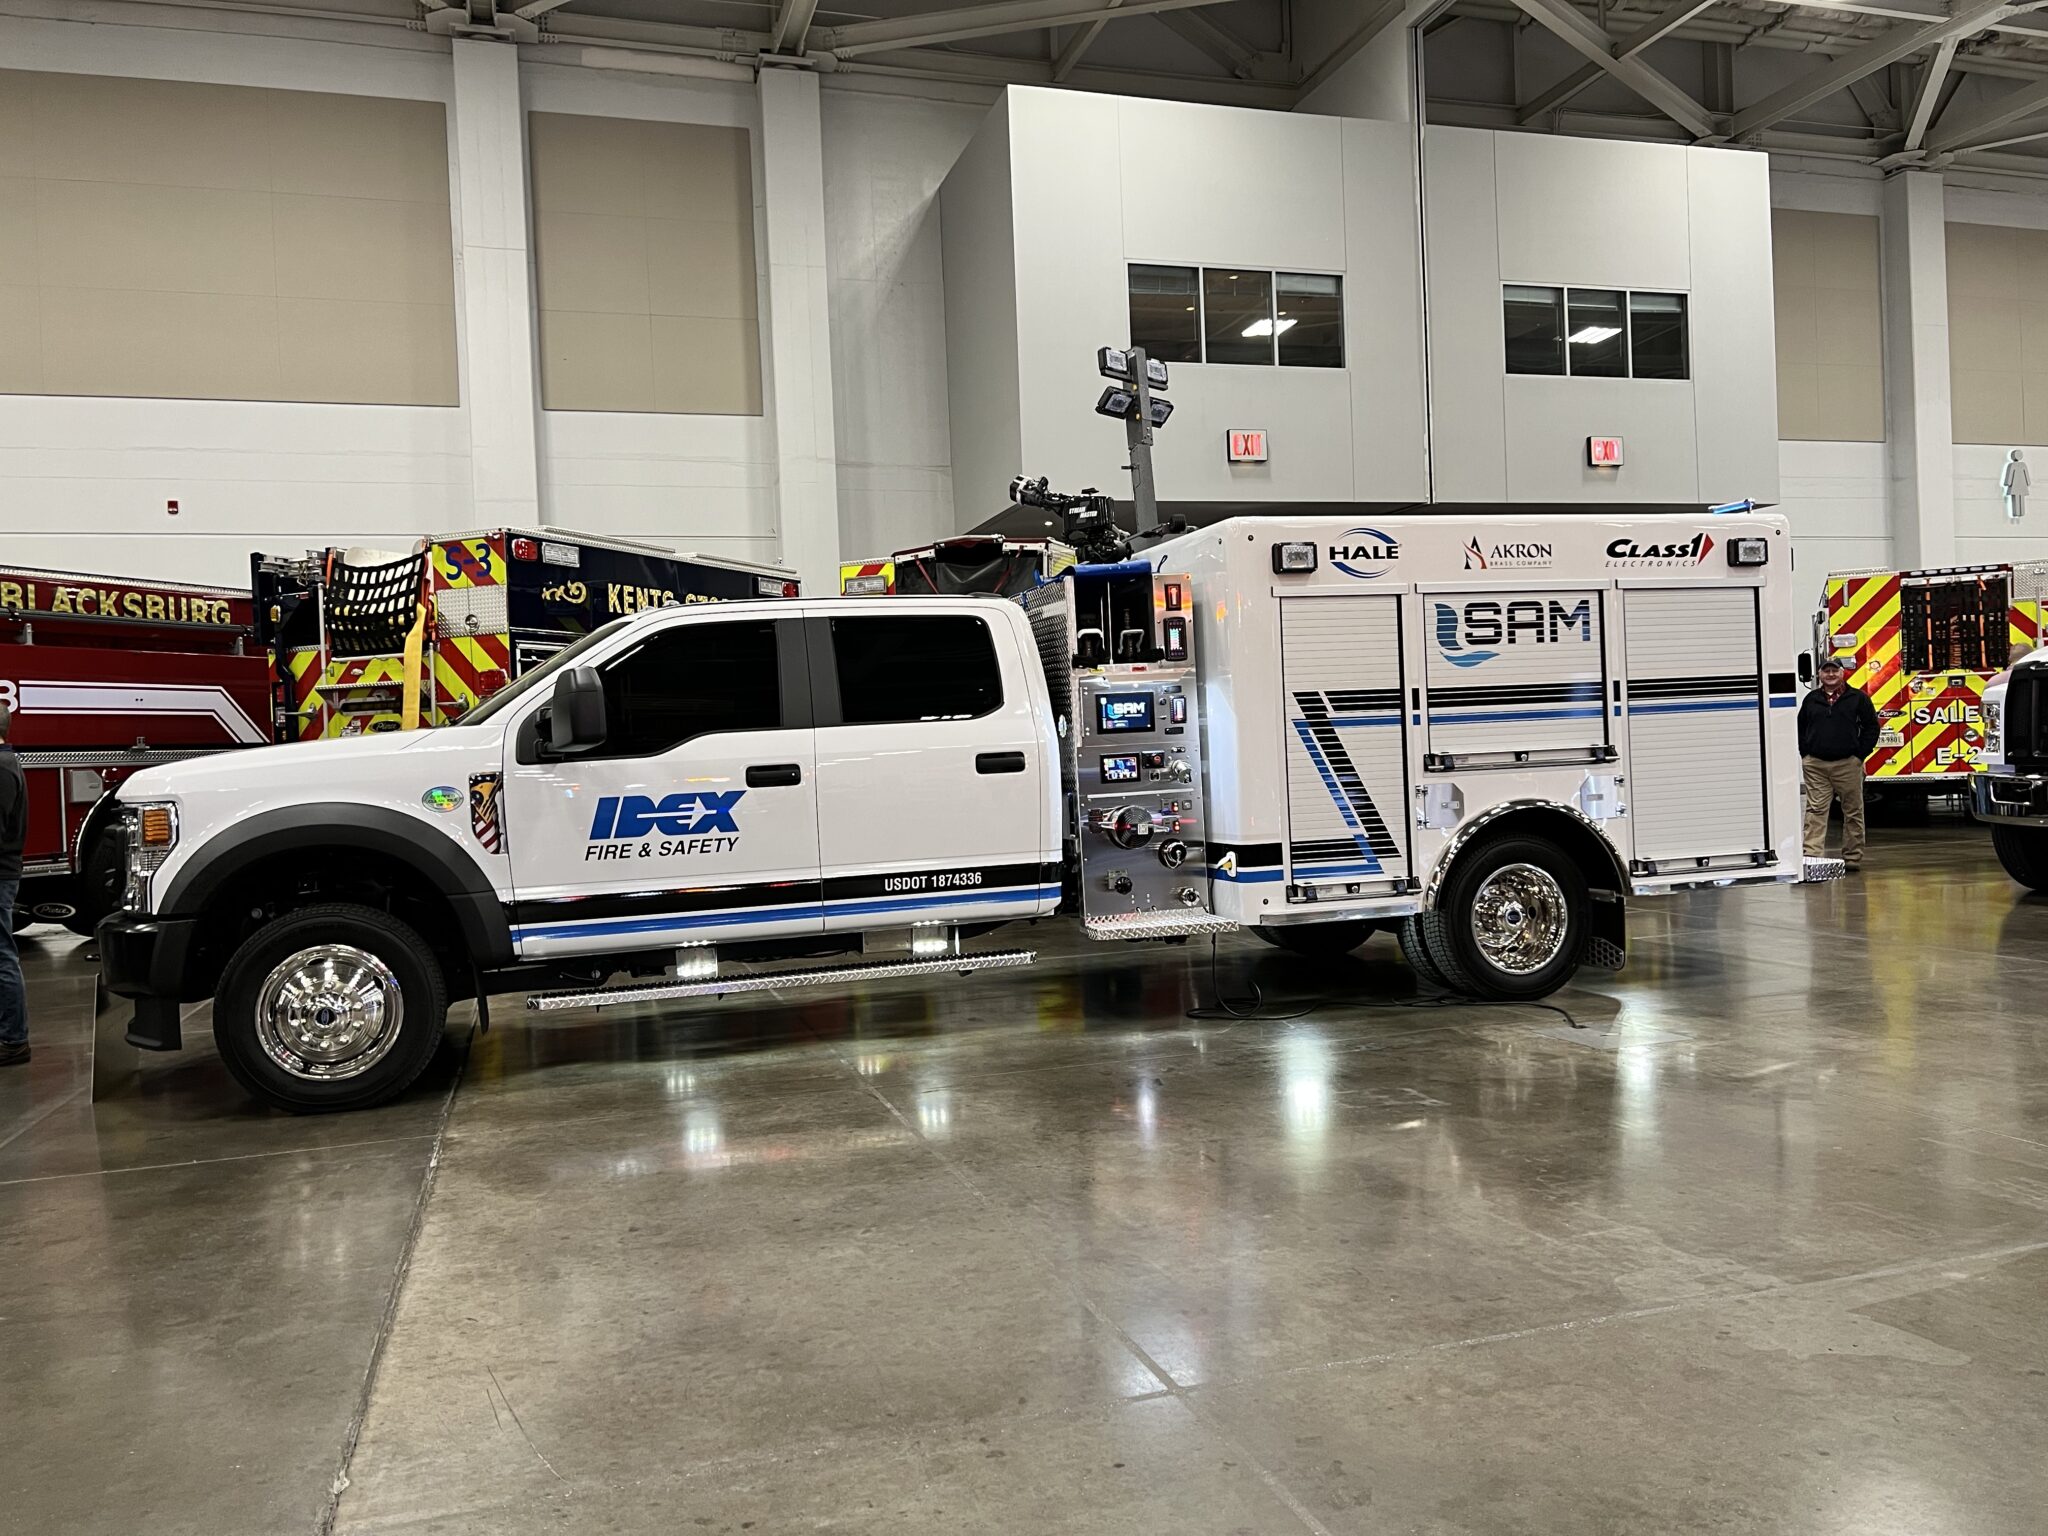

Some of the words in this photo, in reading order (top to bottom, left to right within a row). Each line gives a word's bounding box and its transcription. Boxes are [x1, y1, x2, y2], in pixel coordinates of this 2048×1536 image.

[1233, 433, 1263, 456] EXIT
[1593, 439, 1619, 461] EXIT
[445, 543, 492, 581] S-3
[1329, 545, 1399, 560] HALE
[1490, 543, 1552, 559] AKRON
[1464, 600, 1591, 646] SAM
[1113, 701, 1146, 714] SAM
[589, 790, 747, 841] IDEX
[584, 843, 633, 862] FIRE
[638, 842, 652, 858] &
[658, 836, 740, 856] SAFETY
[884, 875, 927, 892] USDOT
[931, 872, 982, 888] 1874336
